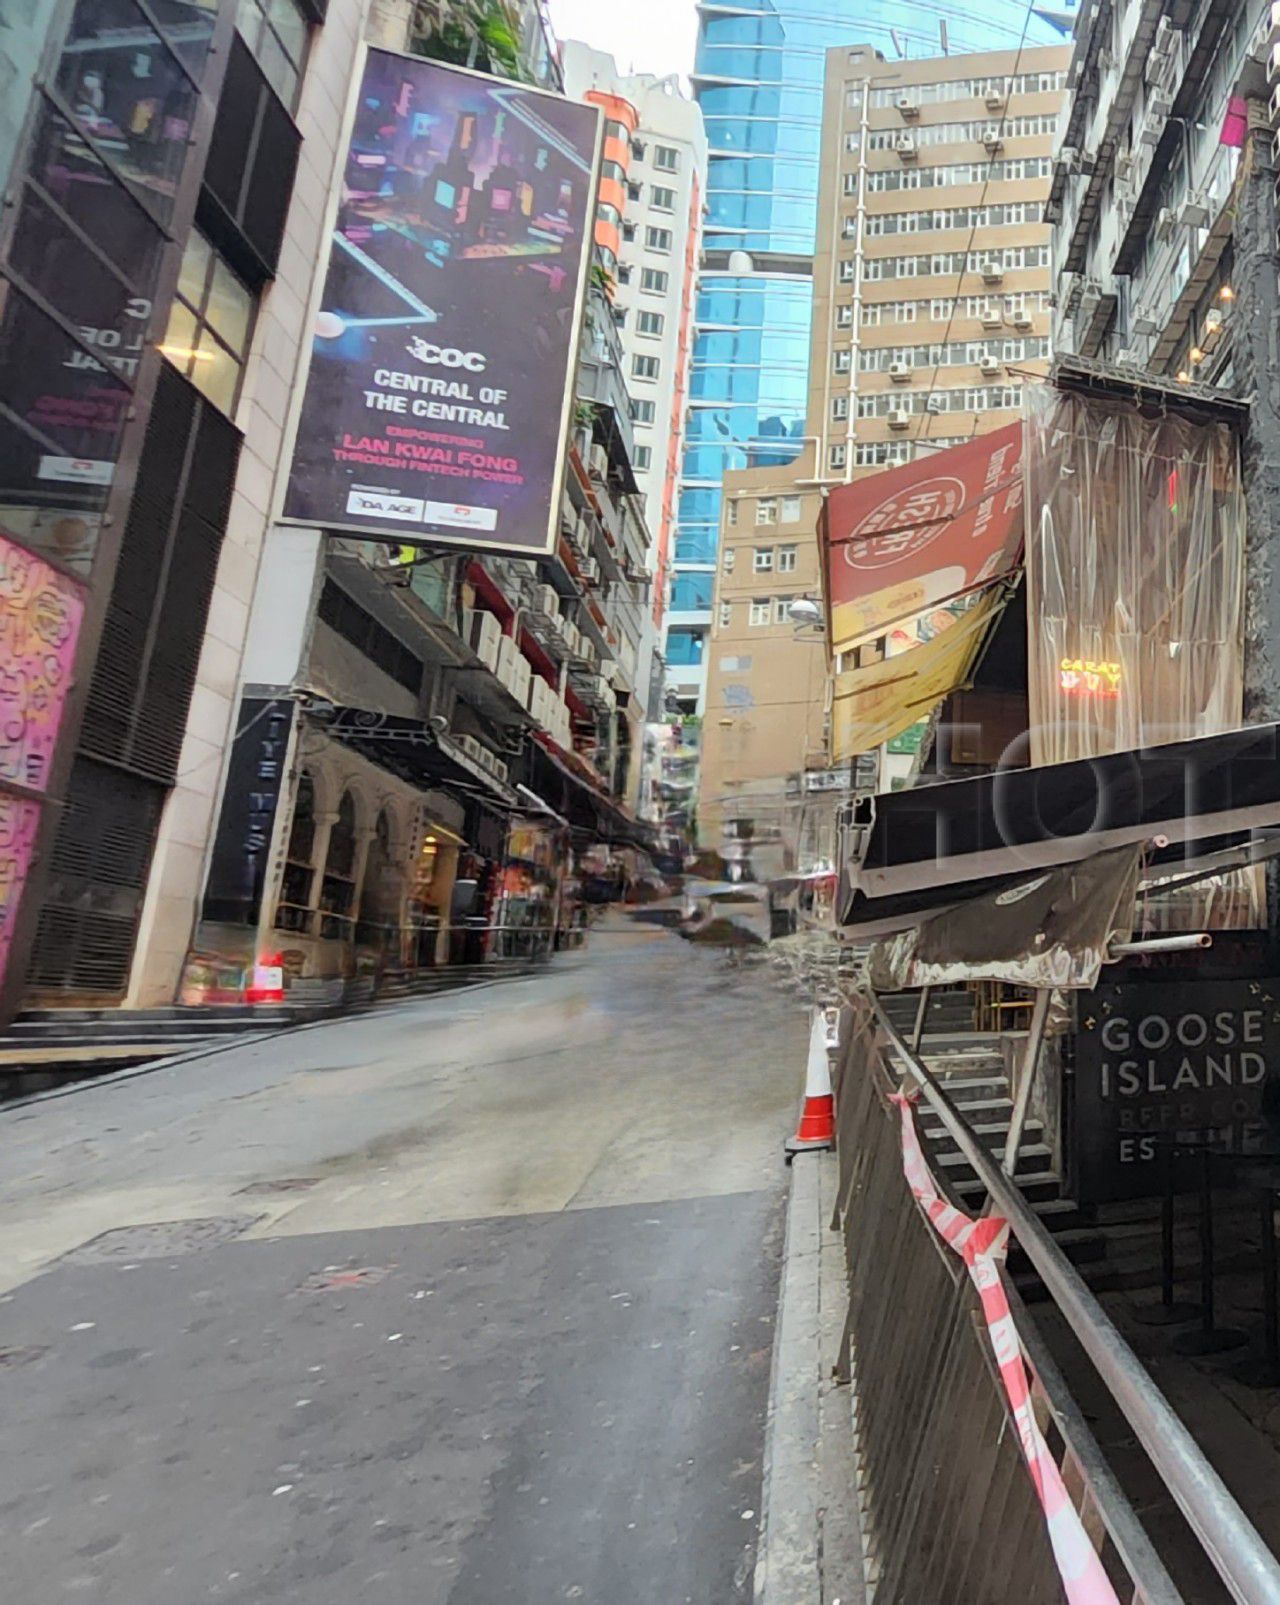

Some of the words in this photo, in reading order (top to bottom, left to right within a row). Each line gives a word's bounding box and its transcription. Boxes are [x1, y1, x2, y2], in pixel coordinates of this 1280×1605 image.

[422, 344, 487, 372] COC
[374, 369, 474, 401] CENTRAL
[479, 387, 508, 405] OF
[363, 390, 409, 414] THE
[412, 400, 510, 430] CENTRAL
[343, 433, 390, 454] LAN
[395, 442, 453, 463] KWAI
[457, 451, 518, 472] FONG
[386, 425, 485, 448] EMPOWERING
[332, 449, 407, 469] THROUGH
[409, 460, 470, 477] FINTECH
[472, 469, 524, 485] POWER
[1101, 1010, 1264, 1052] GOOSE
[1101, 1052, 1266, 1097] ISLAND
